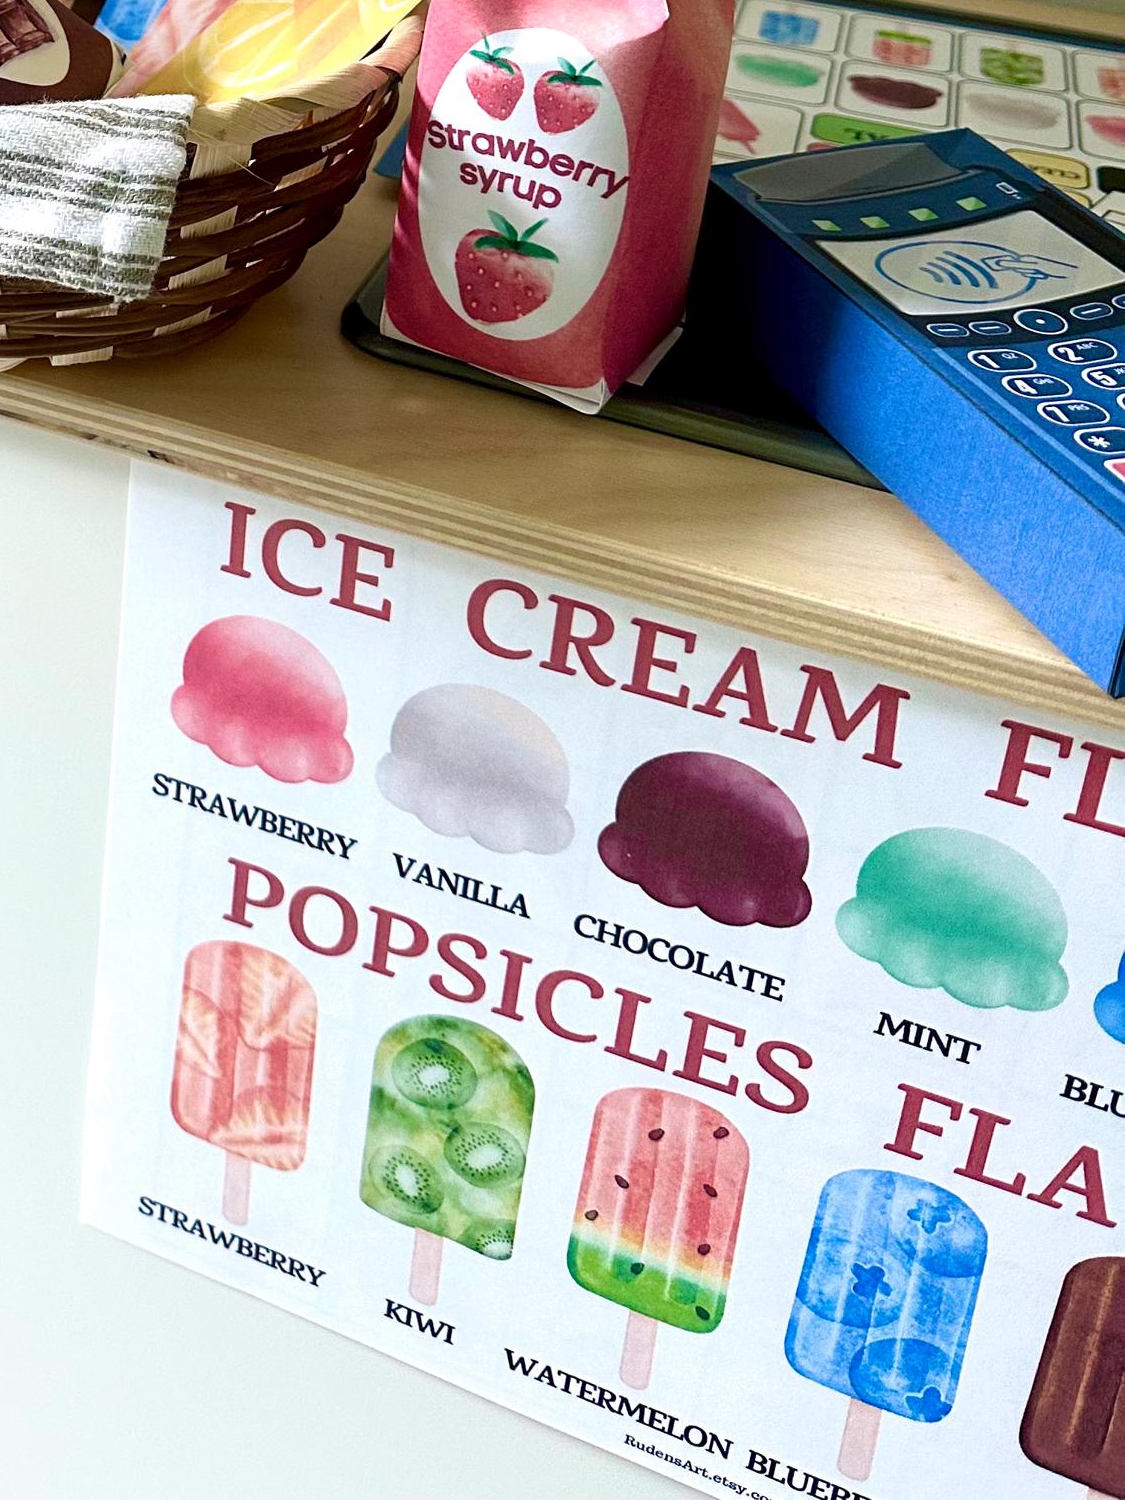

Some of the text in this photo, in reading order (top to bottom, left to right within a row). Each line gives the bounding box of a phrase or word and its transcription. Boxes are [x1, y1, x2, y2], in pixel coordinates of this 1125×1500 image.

[428, 119, 629, 199] Strawberry
[460, 162, 561, 209] syrup
[977, 354, 1001, 369] 1
[1057, 347, 1084, 362] 2
[1089, 371, 1117, 386] 5
[1014, 380, 1038, 395] 4
[1045, 406, 1070, 422] 7
[220, 501, 395, 622] ICE
[466, 578, 911, 769] CREAM
[152, 772, 358, 860] STRAWBERRY
[393, 853, 531, 919] VANILLA
[573, 913, 786, 1002] CHOCOLATE
[222, 856, 1117, 1228] POPSICLES FLA
[873, 1011, 982, 1065] MINT
[138, 1195, 326, 1288] STRAWBERRY
[383, 1298, 457, 1345] KIWI
[504, 1348, 734, 1460] WATERMELON
